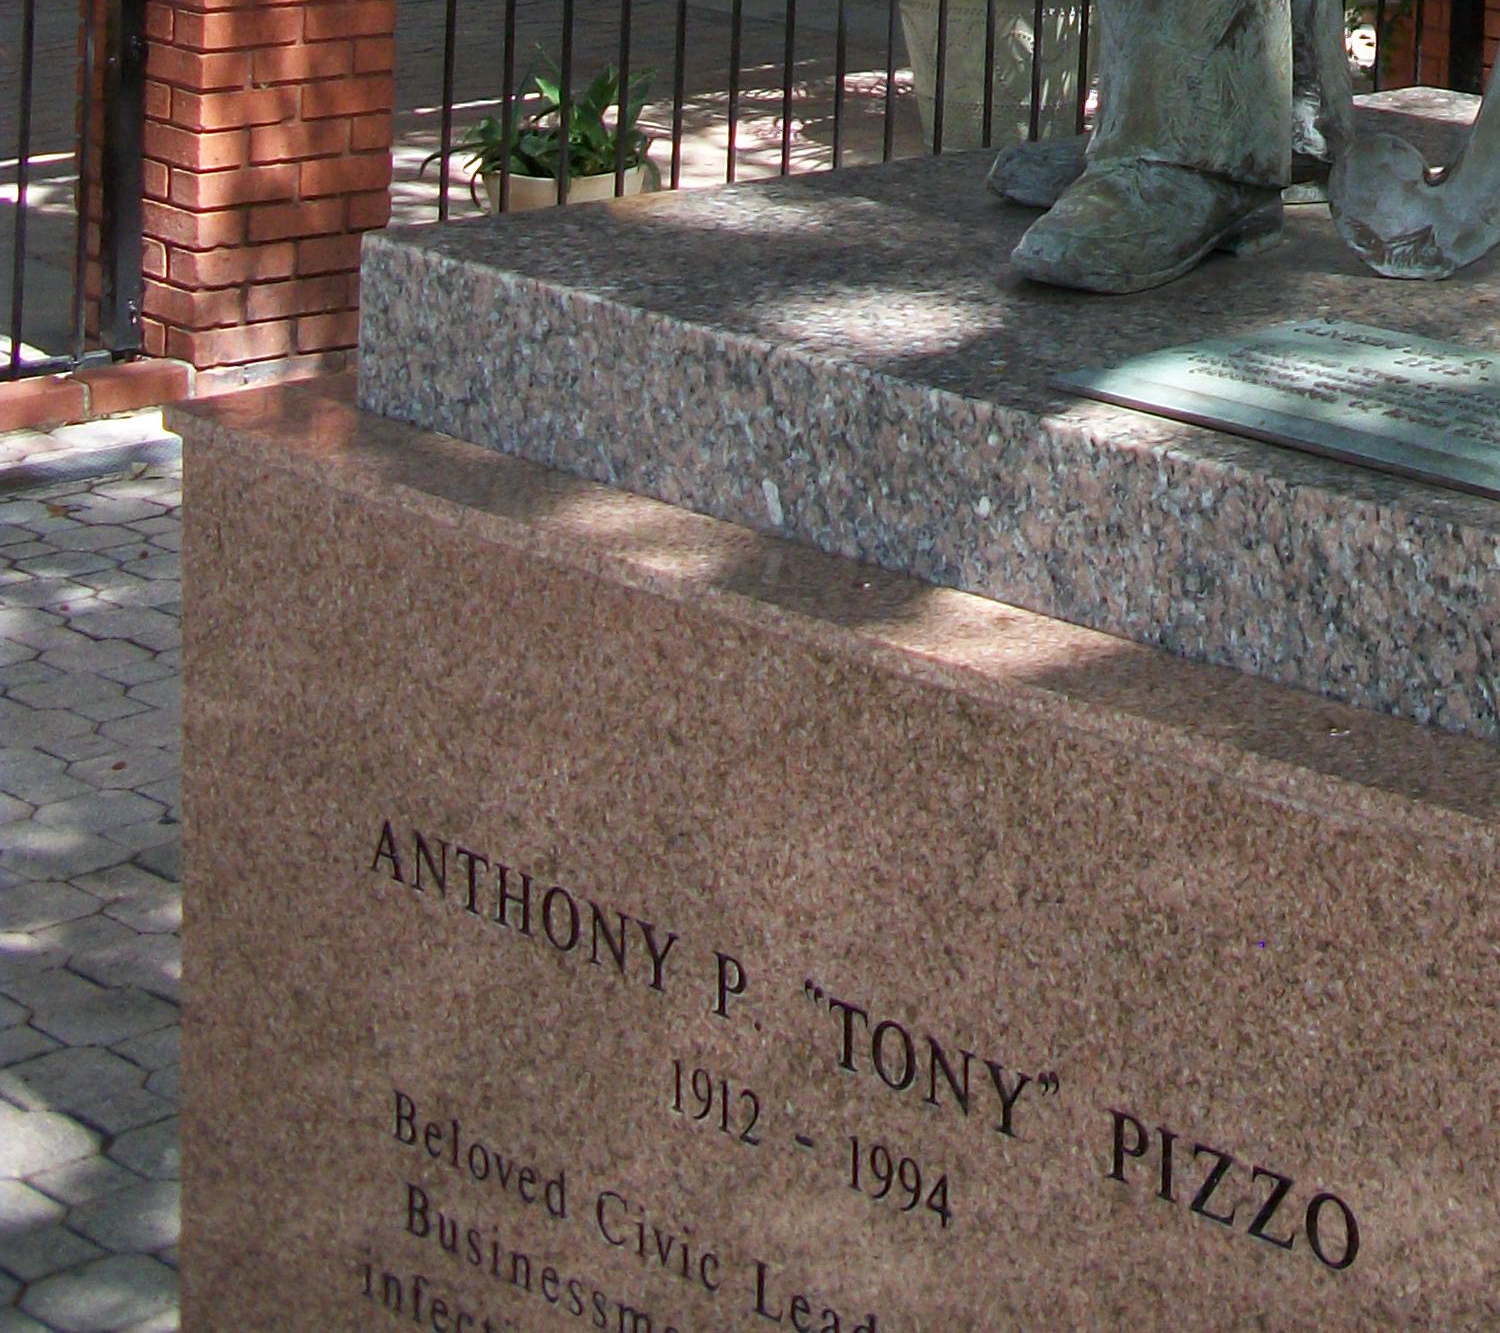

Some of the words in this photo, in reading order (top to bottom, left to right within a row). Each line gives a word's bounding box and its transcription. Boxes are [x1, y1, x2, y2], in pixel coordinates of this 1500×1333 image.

[369, 819, 680, 993] ANTHONY
[712, 950, 763, 1032] P.
[804, 978, 1060, 1139] "TONY"
[1107, 1107, 1360, 1270] PIZZO
[391, 1088, 568, 1220] Beloved
[595, 1189, 721, 1292] Civic
[672, 1059, 760, 1146] 1912
[849, 1135, 952, 1229] 1994
[405, 1182, 681, 1333] Businessm
